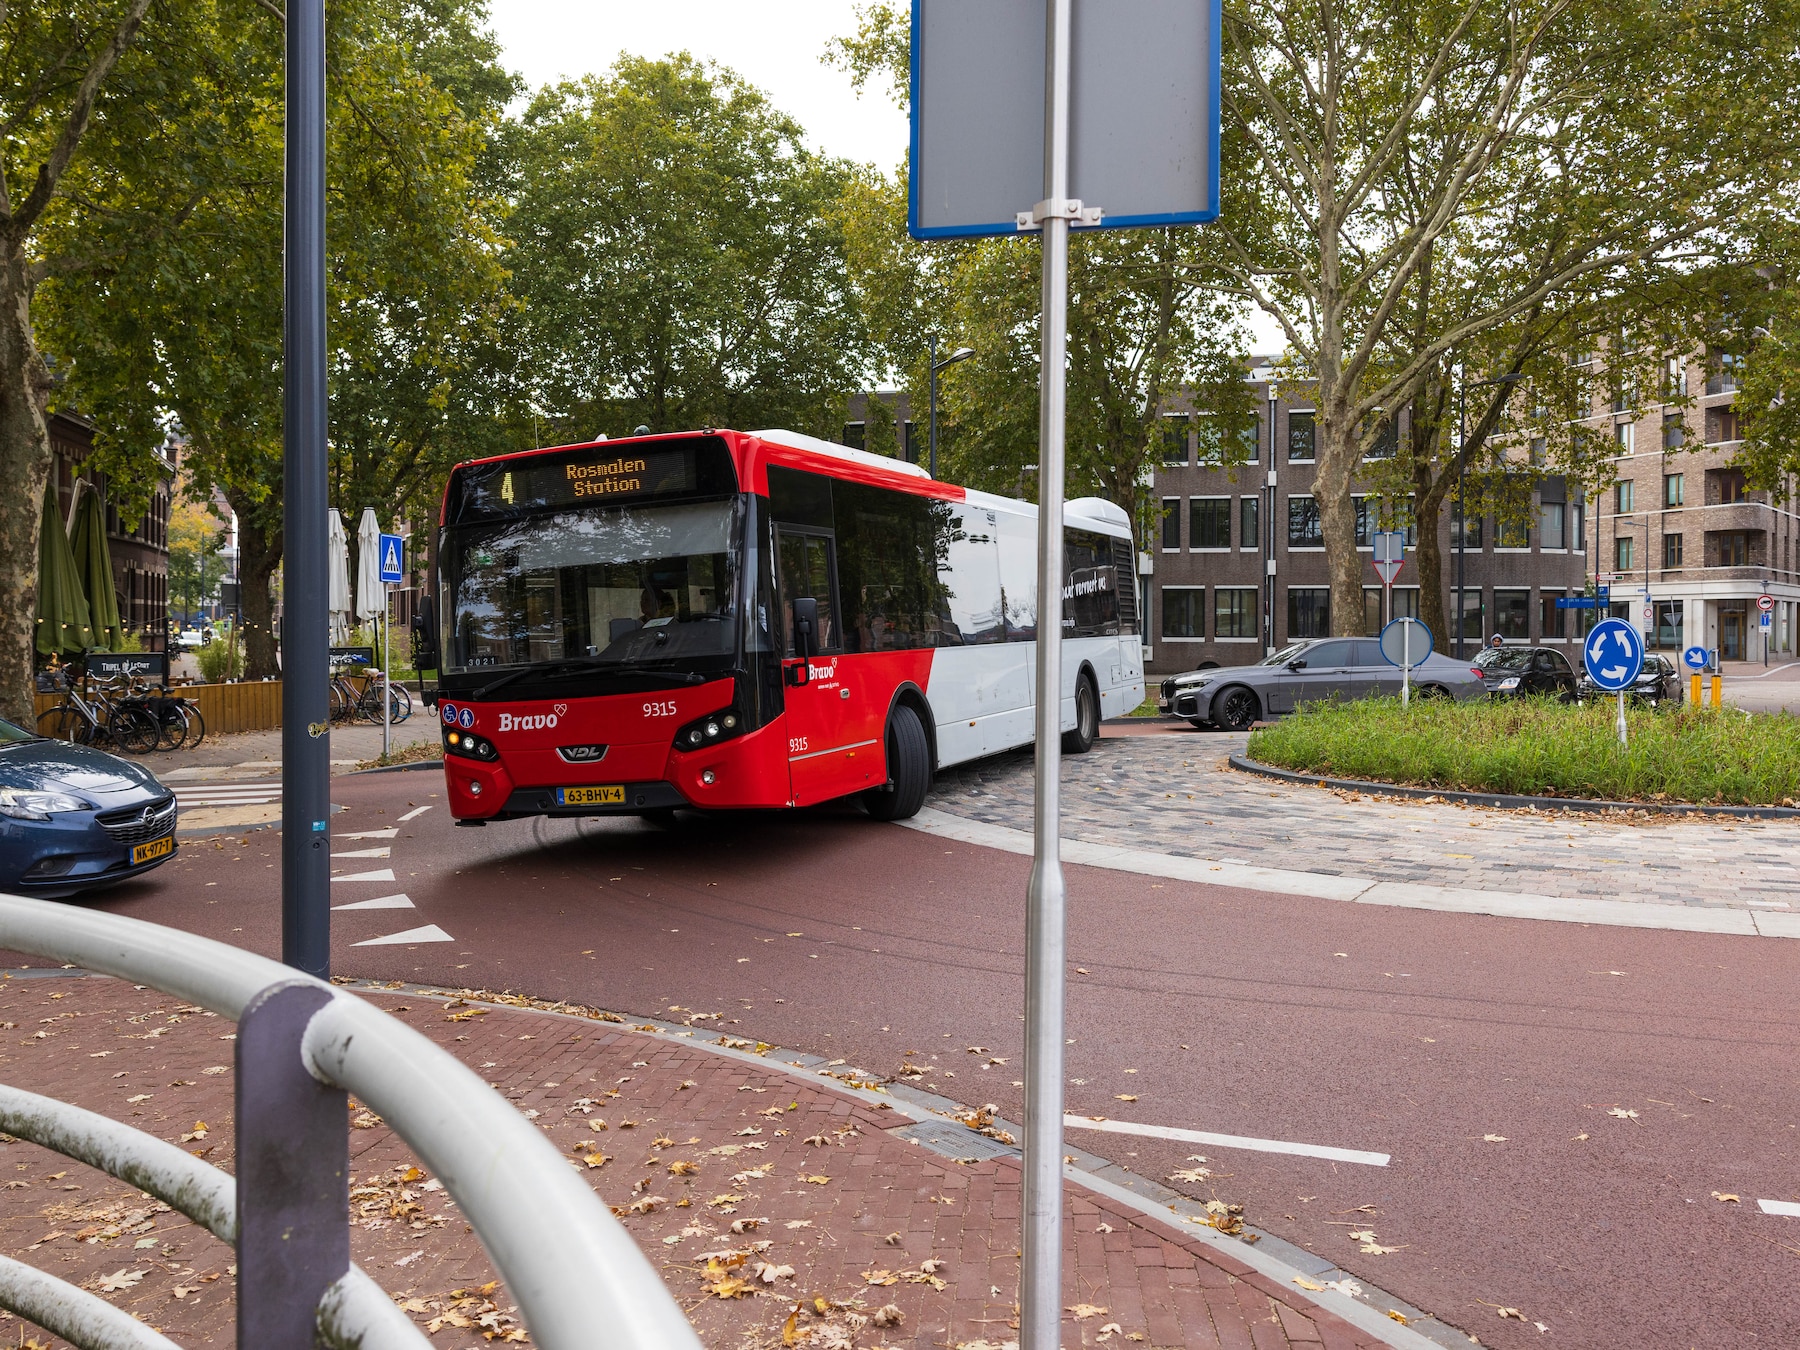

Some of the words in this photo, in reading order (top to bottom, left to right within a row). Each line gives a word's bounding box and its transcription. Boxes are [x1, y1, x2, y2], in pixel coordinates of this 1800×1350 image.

[566, 458, 646, 480] Rosmalen
[501, 472, 515, 505] 4
[573, 477, 641, 497] Station
[1075, 571, 1097, 596] vervoert
[468, 657, 495, 666] 3021
[809, 664, 834, 681] Bravo
[642, 701, 677, 718] 9315
[498, 713, 558, 732] Bravo
[564, 746, 600, 758] VDL
[789, 737, 809, 752] 9315
[568, 788, 622, 802] 63-BHV-4
[136, 839, 170, 861] NK-977-T
